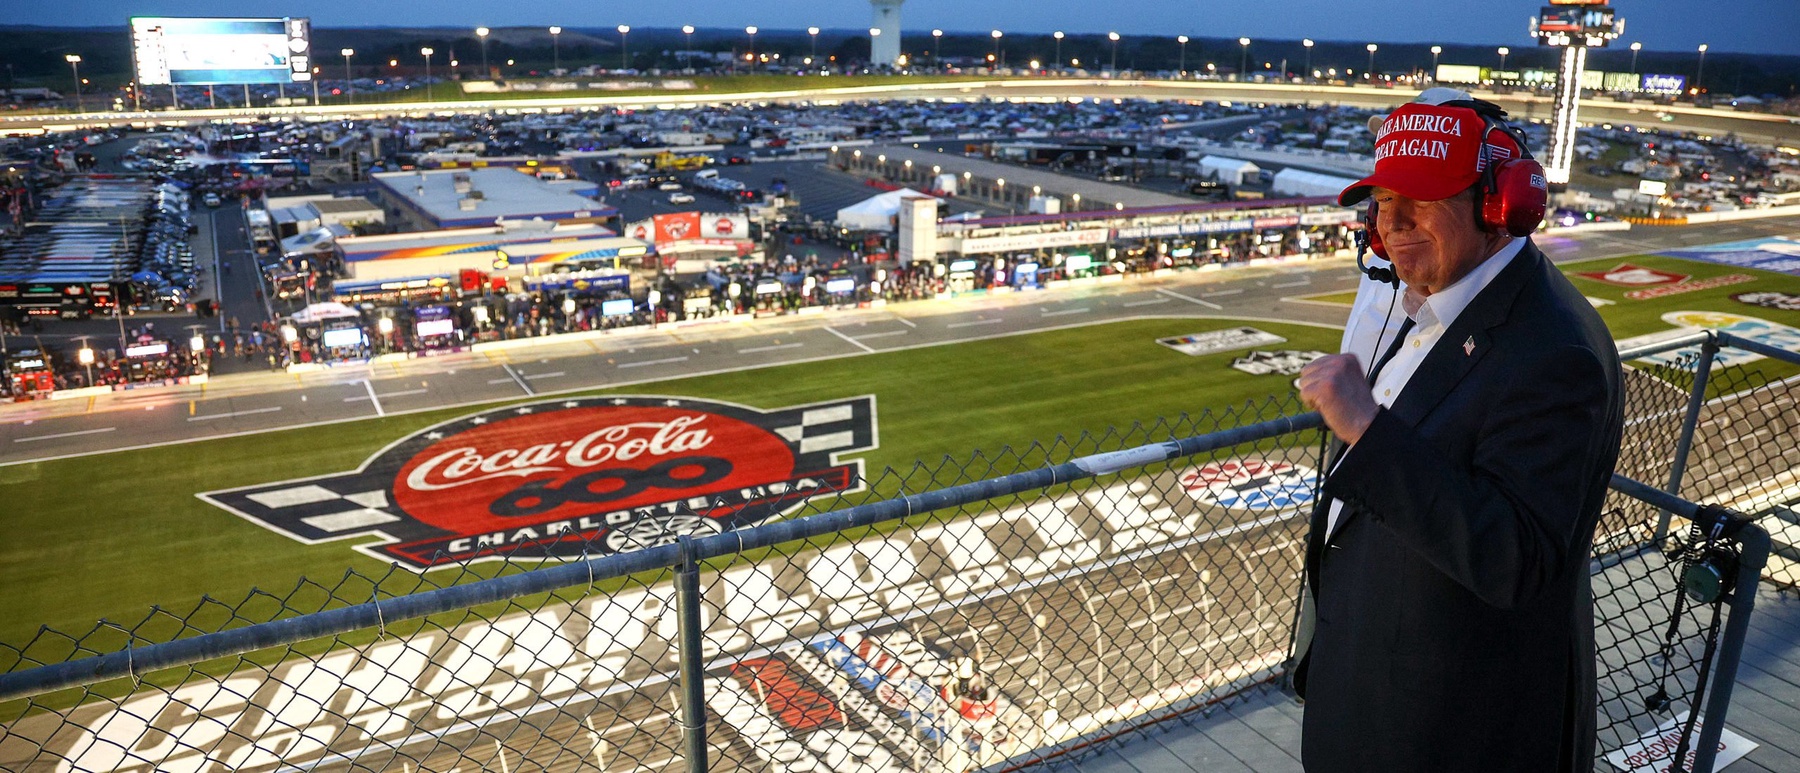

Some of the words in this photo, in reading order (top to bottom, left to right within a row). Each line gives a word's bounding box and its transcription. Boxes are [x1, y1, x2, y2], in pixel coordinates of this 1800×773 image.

[1644, 75, 1682, 90] xfinity
[1392, 114, 1462, 137] AMERICA
[1374, 140, 1398, 165] REAT
[1397, 139, 1450, 161] AGAIN
[406, 414, 714, 491] Coca-Cola
[488, 456, 734, 517] 600
[740, 477, 820, 500] USA
[54, 482, 1172, 773] CHARLOTTE
